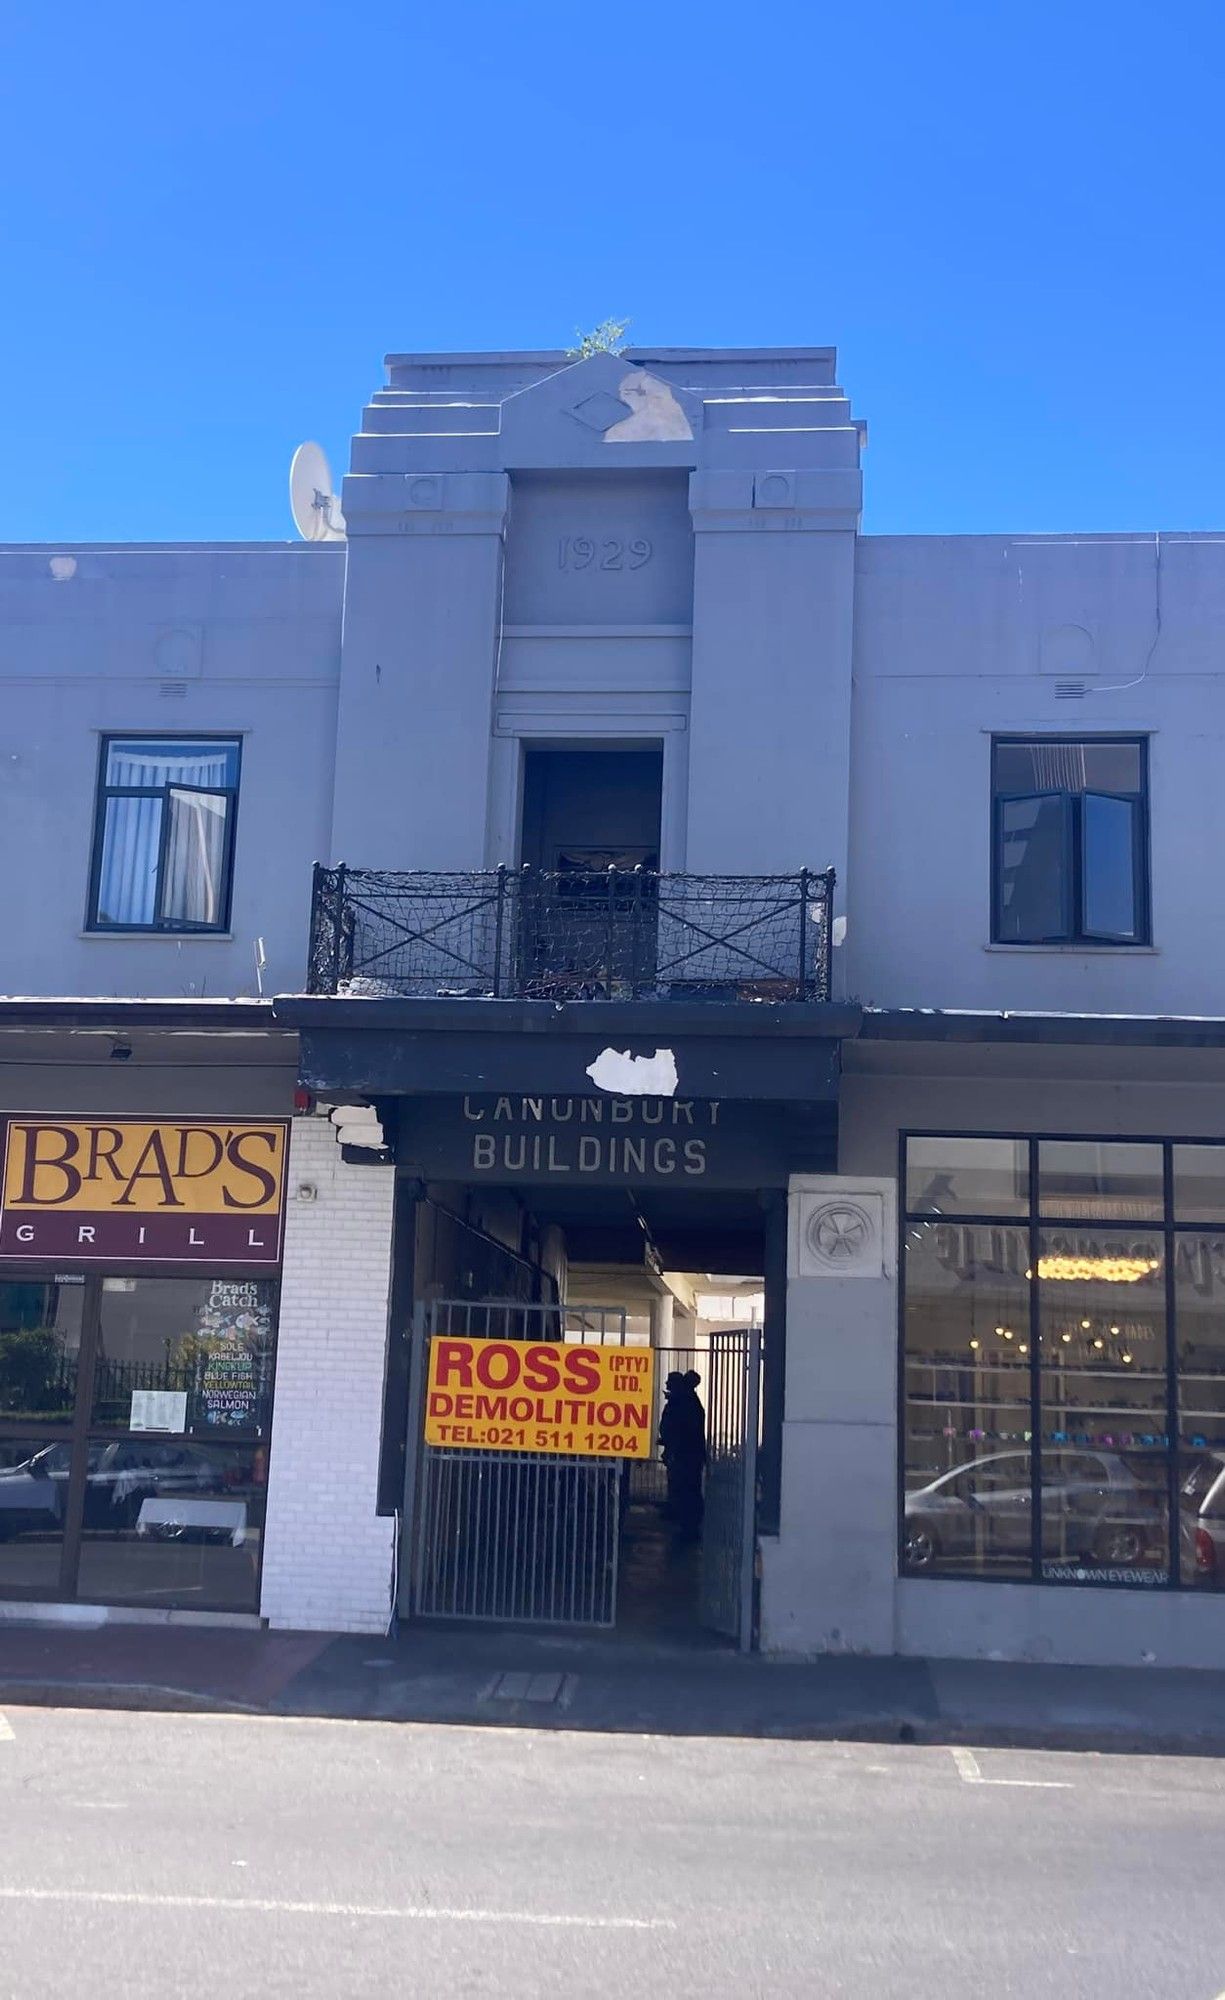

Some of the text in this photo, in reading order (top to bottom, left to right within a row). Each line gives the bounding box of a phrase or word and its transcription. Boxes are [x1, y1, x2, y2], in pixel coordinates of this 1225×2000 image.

[558, 537, 652, 571] 1929
[473, 1134, 706, 1174] BUILDINGS
[10, 1126, 277, 1208] BRAD'S
[16, 1225, 264, 1247] GRILL
[211, 1280, 257, 1295] Brad's
[209, 1294, 258, 1308] Catch
[220, 1342, 244, 1352] SOLE
[204, 1371, 253, 1380] BLUE FISH
[435, 1341, 601, 1394] ROSS
[613, 1374, 642, 1393] LTD.
[202, 1389, 256, 1400] NORWEGIAN
[207, 1399, 249, 1410] SALMON
[429, 1392, 648, 1428] DEMOLITION
[437, 1424, 638, 1452] TEL:021 511 1204
